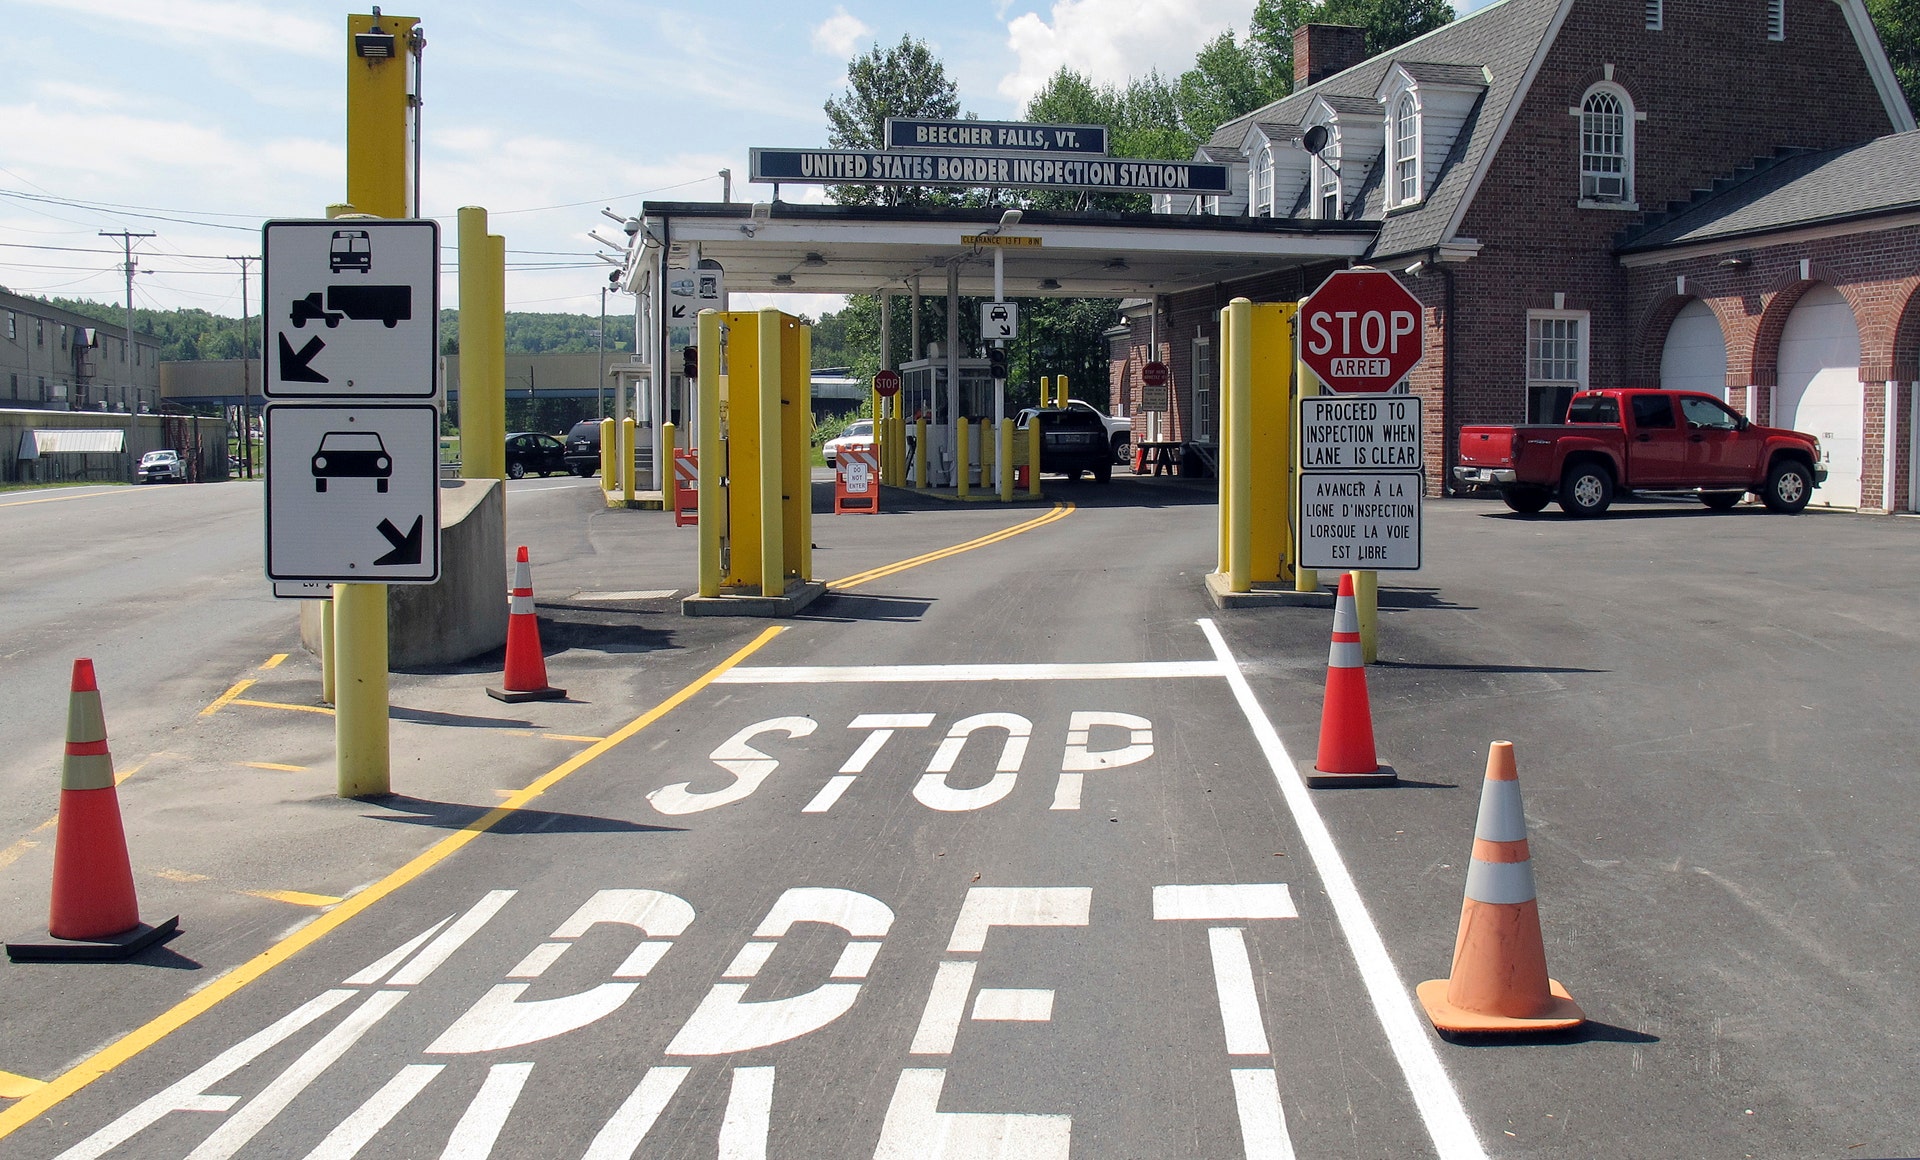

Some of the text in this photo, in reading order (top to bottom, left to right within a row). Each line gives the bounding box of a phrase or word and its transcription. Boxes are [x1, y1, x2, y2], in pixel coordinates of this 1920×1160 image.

[916, 125, 1080, 150] BEECHER FALLS, VT.
[801, 154, 1189, 188] UNITED STATES BORDER INSPECTION STATION
[1308, 310, 1415, 355] STOP
[1335, 360, 1386, 375] ARRET
[876, 378, 898, 388] STOP
[1316, 402, 1405, 420] PROCEED TO
[1306, 424, 1415, 443] INSPECTION WHEN
[1307, 447, 1415, 465] LANE IS CLEAR
[1316, 483, 1366, 496] AVANCER
[1389, 483, 1404, 497] LA
[1306, 503, 1414, 518] LIGNE D'INSPECTION
[1310, 524, 1410, 539] LORSQUE LA VOIE
[1332, 545, 1387, 560] EST LIBRE
[645, 711, 1154, 815] STOP
